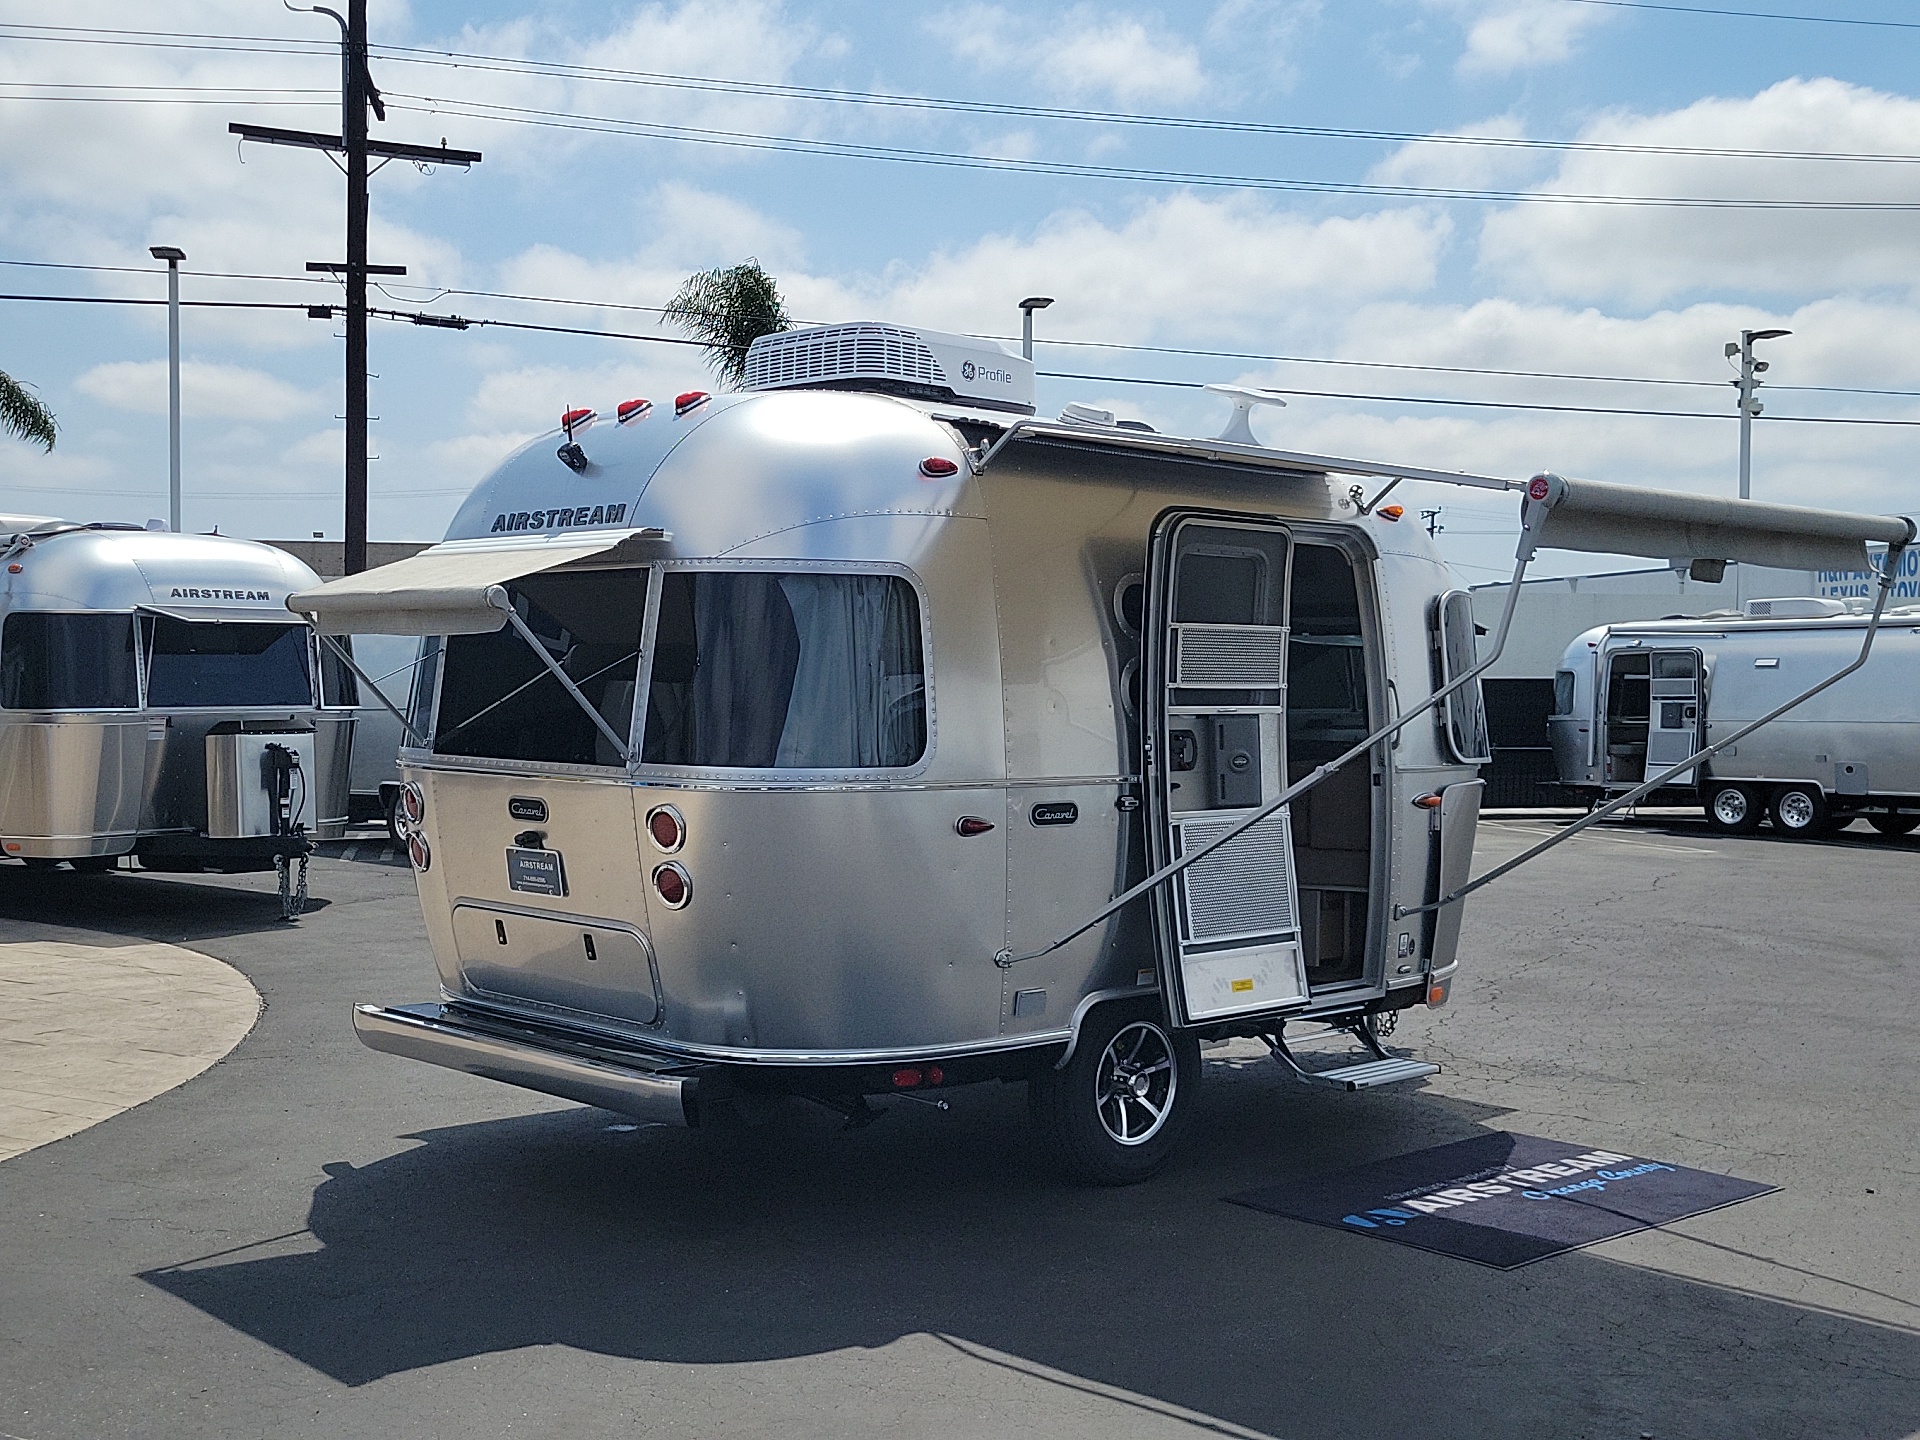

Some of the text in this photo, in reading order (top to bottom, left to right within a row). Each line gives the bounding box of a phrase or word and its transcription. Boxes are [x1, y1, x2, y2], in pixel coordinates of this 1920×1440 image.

[978, 366, 1012, 384] Profile
[490, 503, 627, 533] AIRSTREAM
[170, 588, 270, 601] AIRSTREAM
[511, 802, 544, 817] Caravel
[1035, 807, 1076, 820] Caravel
[519, 860, 554, 871] AIRSTREAM
[1401, 1150, 1634, 1214] AIRSTREAM
[1521, 1178, 1608, 1201] Orange
[1596, 1162, 1676, 1182] County
